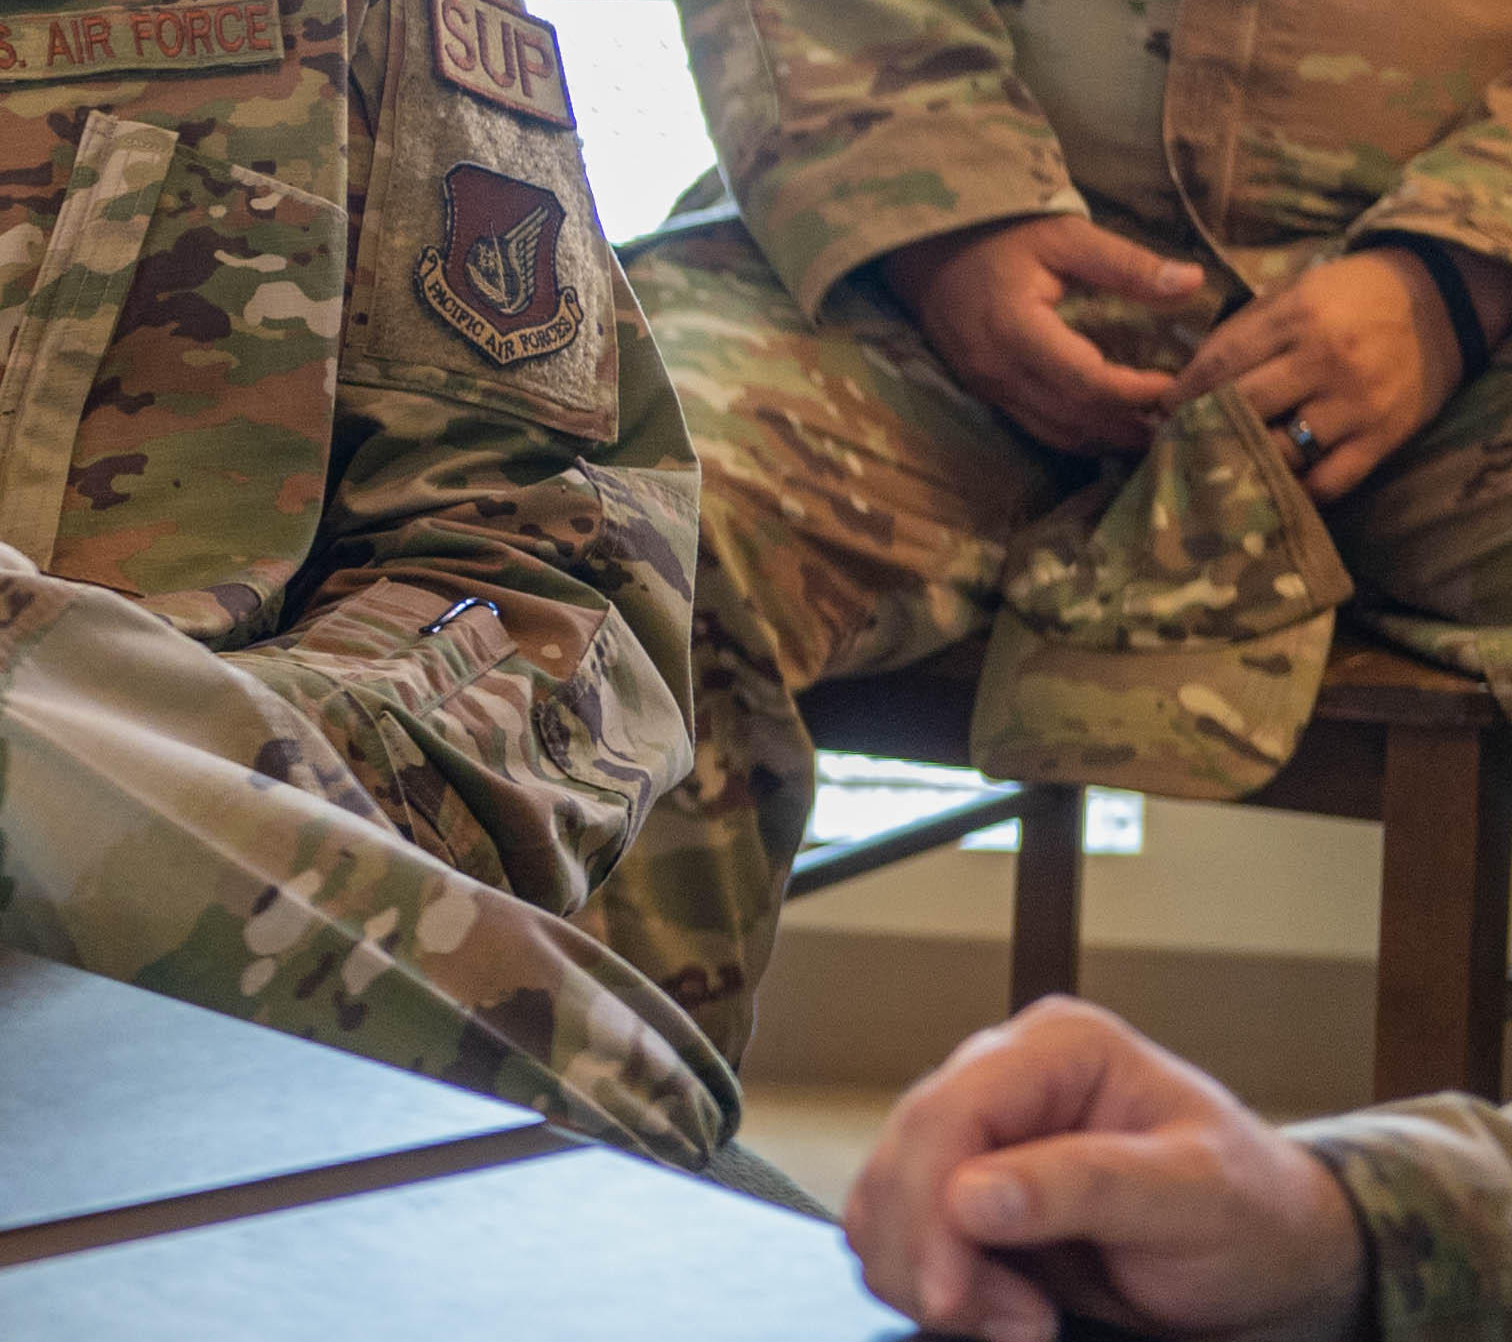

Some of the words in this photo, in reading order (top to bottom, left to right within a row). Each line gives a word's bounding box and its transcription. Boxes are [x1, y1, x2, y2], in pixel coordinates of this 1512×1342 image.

[46, 16, 113, 68] AIR
[134, 3, 273, 61] FORCE
[429, 281, 484, 336] PACIFIC
[486, 334, 515, 358] AIR
[519, 317, 571, 351] FORCES
